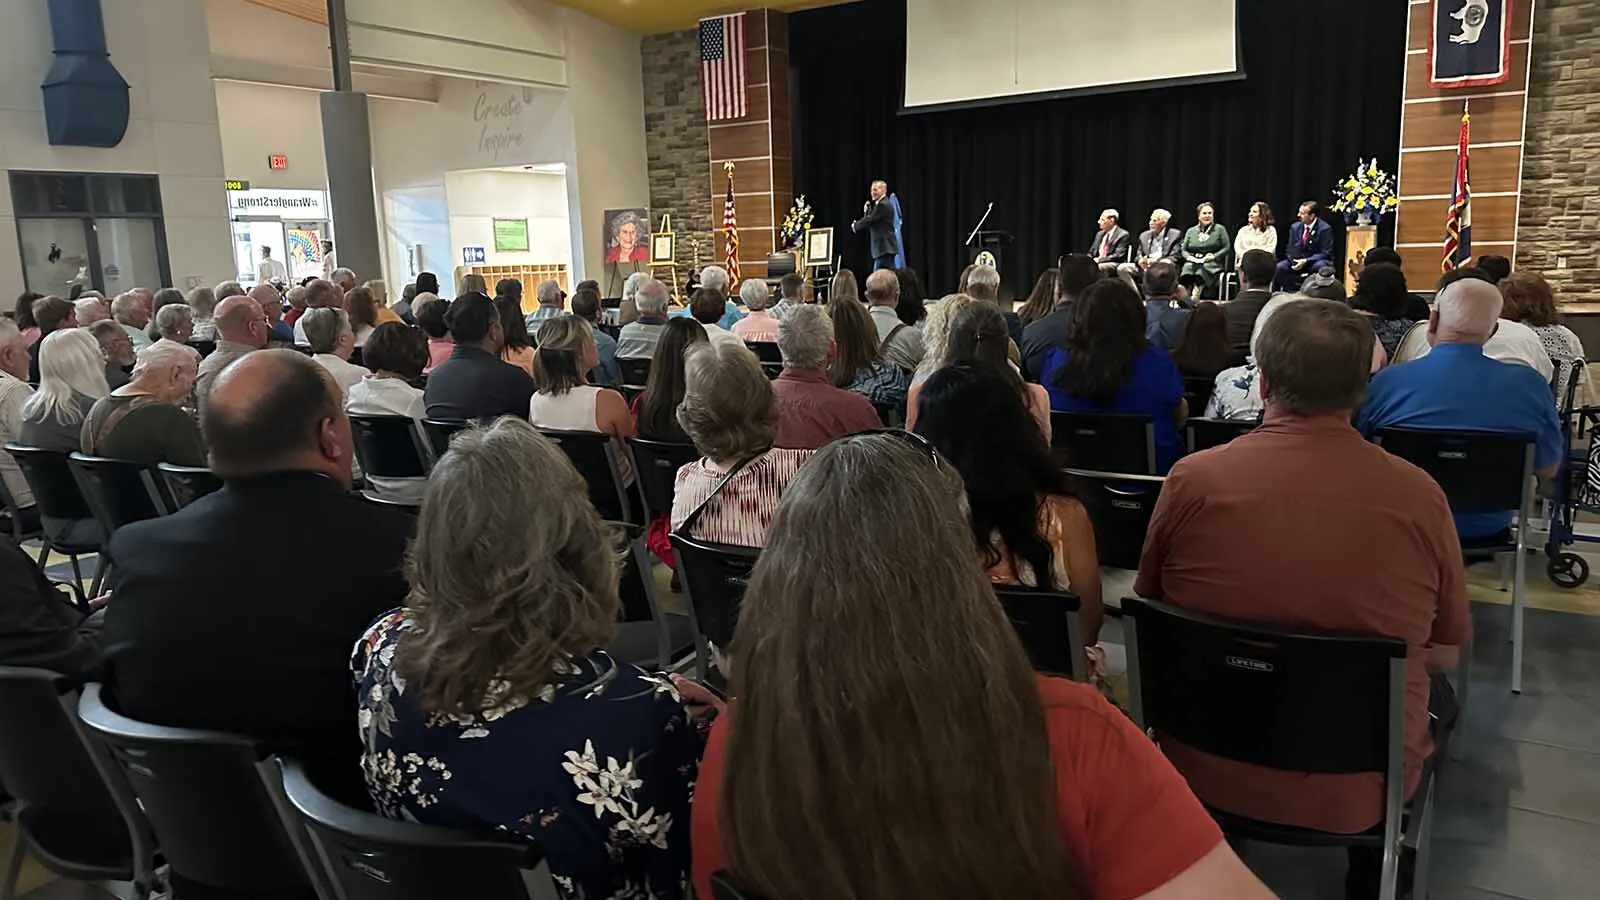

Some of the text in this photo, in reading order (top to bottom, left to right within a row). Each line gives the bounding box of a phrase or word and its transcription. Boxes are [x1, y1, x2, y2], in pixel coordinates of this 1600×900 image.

[474, 92, 521, 121] Create
[479, 124, 525, 160] Inspire
[272, 156, 286, 168] EXIT
